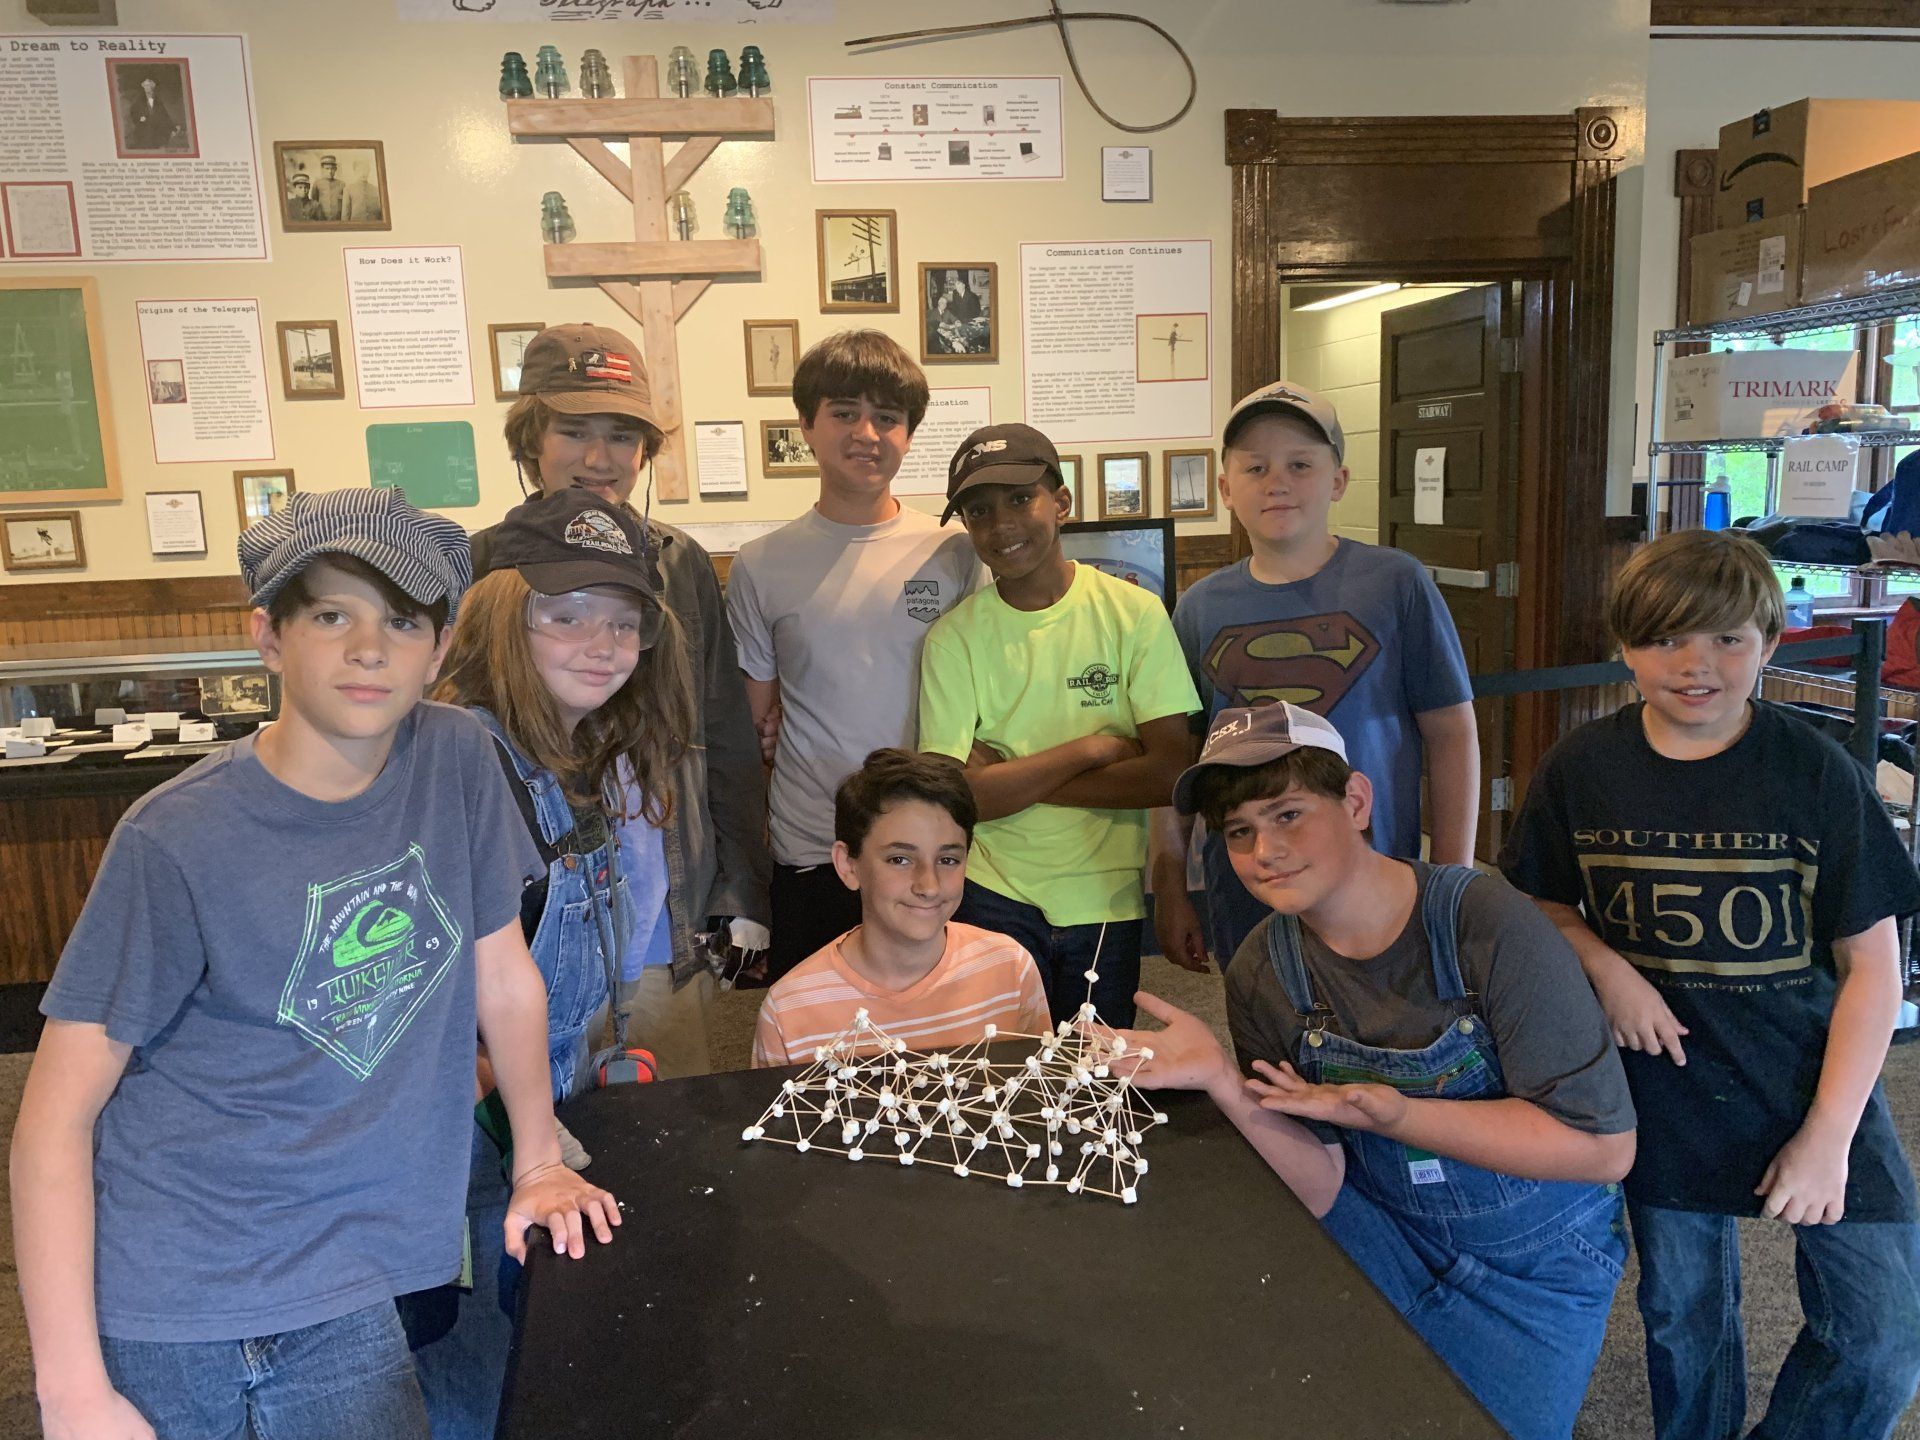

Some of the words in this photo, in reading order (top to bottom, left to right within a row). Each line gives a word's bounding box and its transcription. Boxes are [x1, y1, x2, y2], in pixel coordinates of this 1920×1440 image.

[10, 40, 61, 51] Dream
[70, 40, 89, 51] to
[98, 40, 167, 54] Reality
[884, 82, 927, 90] Constant
[930, 82, 998, 90] Communication
[1046, 248, 1124, 257] Communication
[1129, 246, 1183, 256] Continues
[359, 257, 376, 265] How
[381, 256, 403, 265] Does
[409, 256, 420, 264] it
[424, 256, 452, 264] Work?
[139, 307, 174, 315] Origins
[178, 306, 188, 314] of
[212, 305, 257, 314] Telegraph
[1728, 380, 1839, 398] TRIMARK
[927, 399, 969, 407] nication
[1418, 404, 1449, 418] STAIRWAY
[1787, 460, 1813, 473] RAIL
[1815, 459, 1849, 473] CAMP
[906, 598, 939, 606] patagonia
[1069, 678, 1092, 688] RAIL
[1080, 699, 1101, 709] RAIL
[1572, 829, 1820, 856] SOUTHERN
[318, 933, 333, 954] THE
[329, 887, 370, 934] MOUNTAIN
[373, 882, 387, 896] AND
[390, 880, 405, 892] THE
[1604, 881, 1798, 950] 4501
[425, 936, 440, 950] 69
[306, 998, 318, 1011] 19
